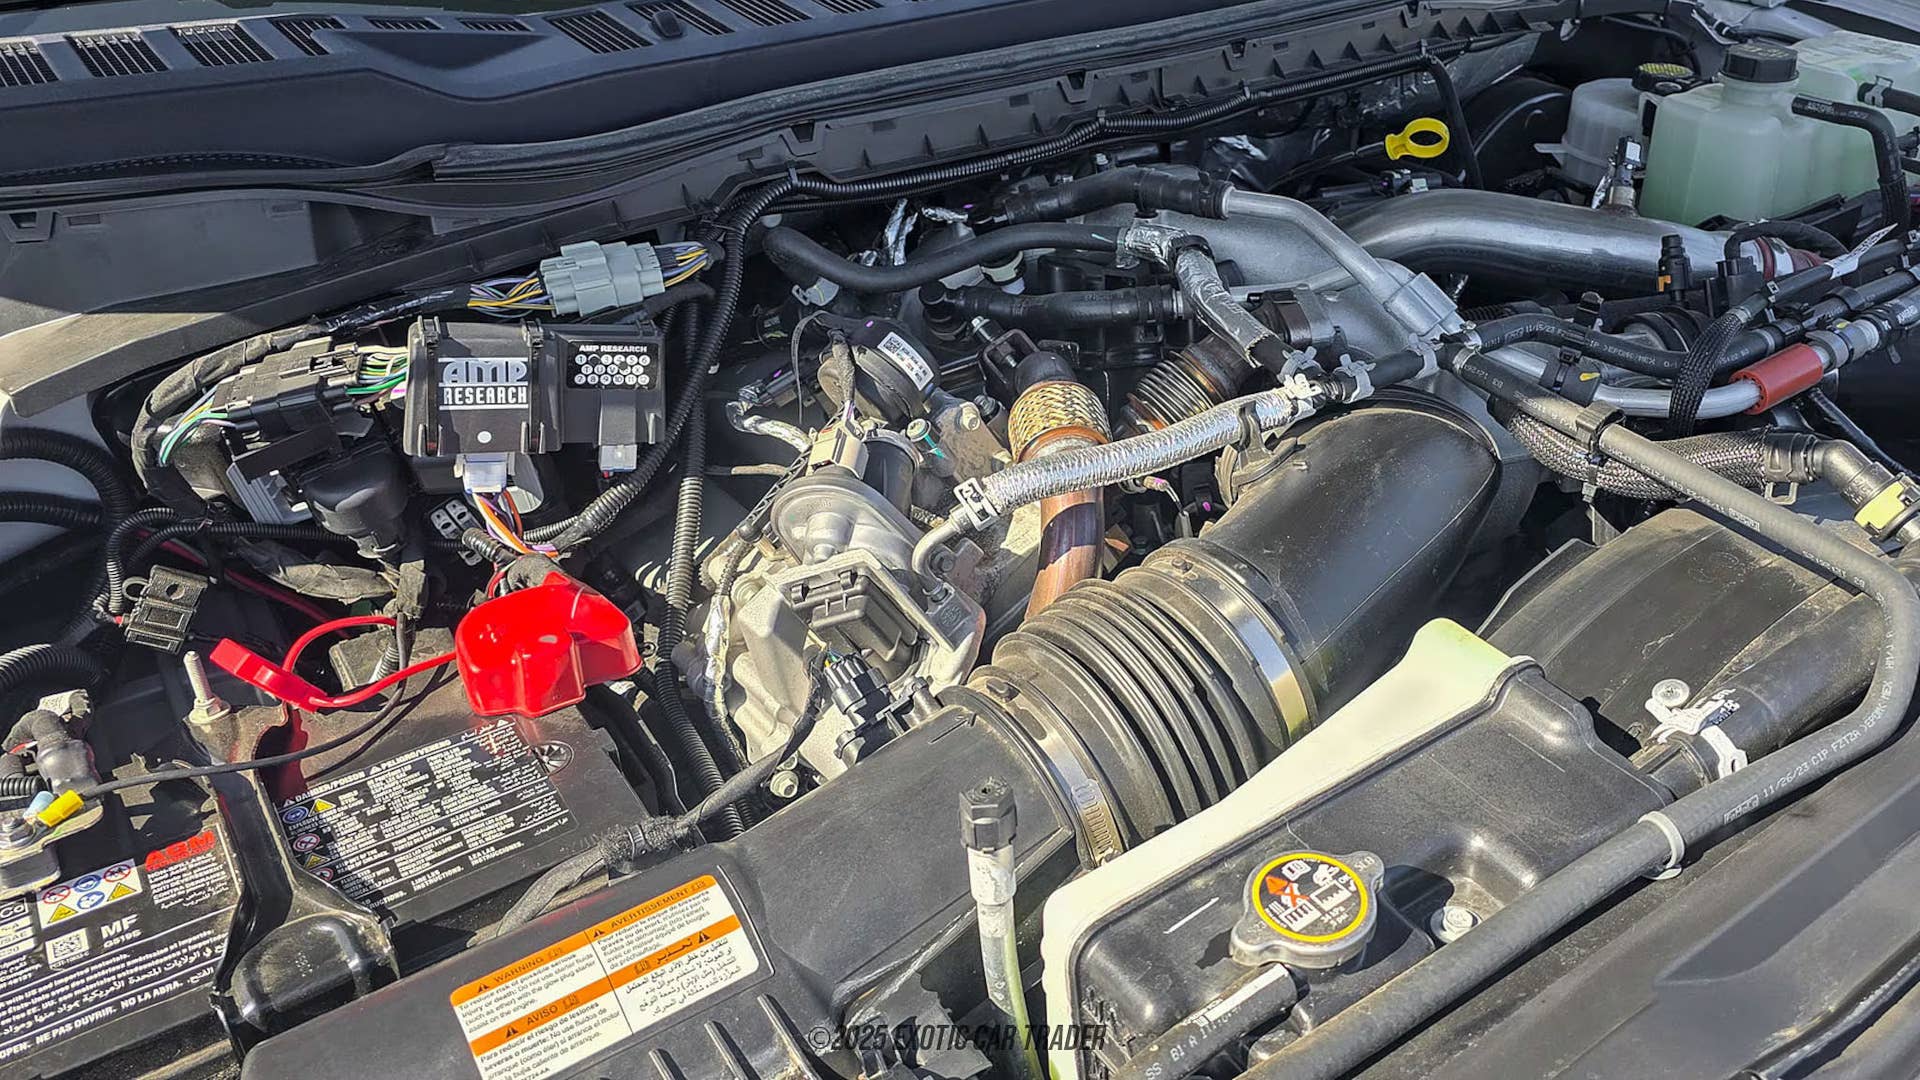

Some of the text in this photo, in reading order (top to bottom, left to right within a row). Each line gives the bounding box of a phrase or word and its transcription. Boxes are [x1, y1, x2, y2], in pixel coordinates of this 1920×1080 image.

[443, 360, 527, 384] AMP
[444, 387, 527, 405] RESEARCH
[609, 888, 689, 928] AVERTISSEMENT
[100, 912, 138, 941] MF
[493, 955, 544, 984] WARNING
[35, 1030, 51, 1045] NE
[52, 1021, 73, 1038] PAS
[120, 995, 136, 1011] NO
[137, 990, 151, 1004] LA
[525, 1003, 558, 1025] AVISO
